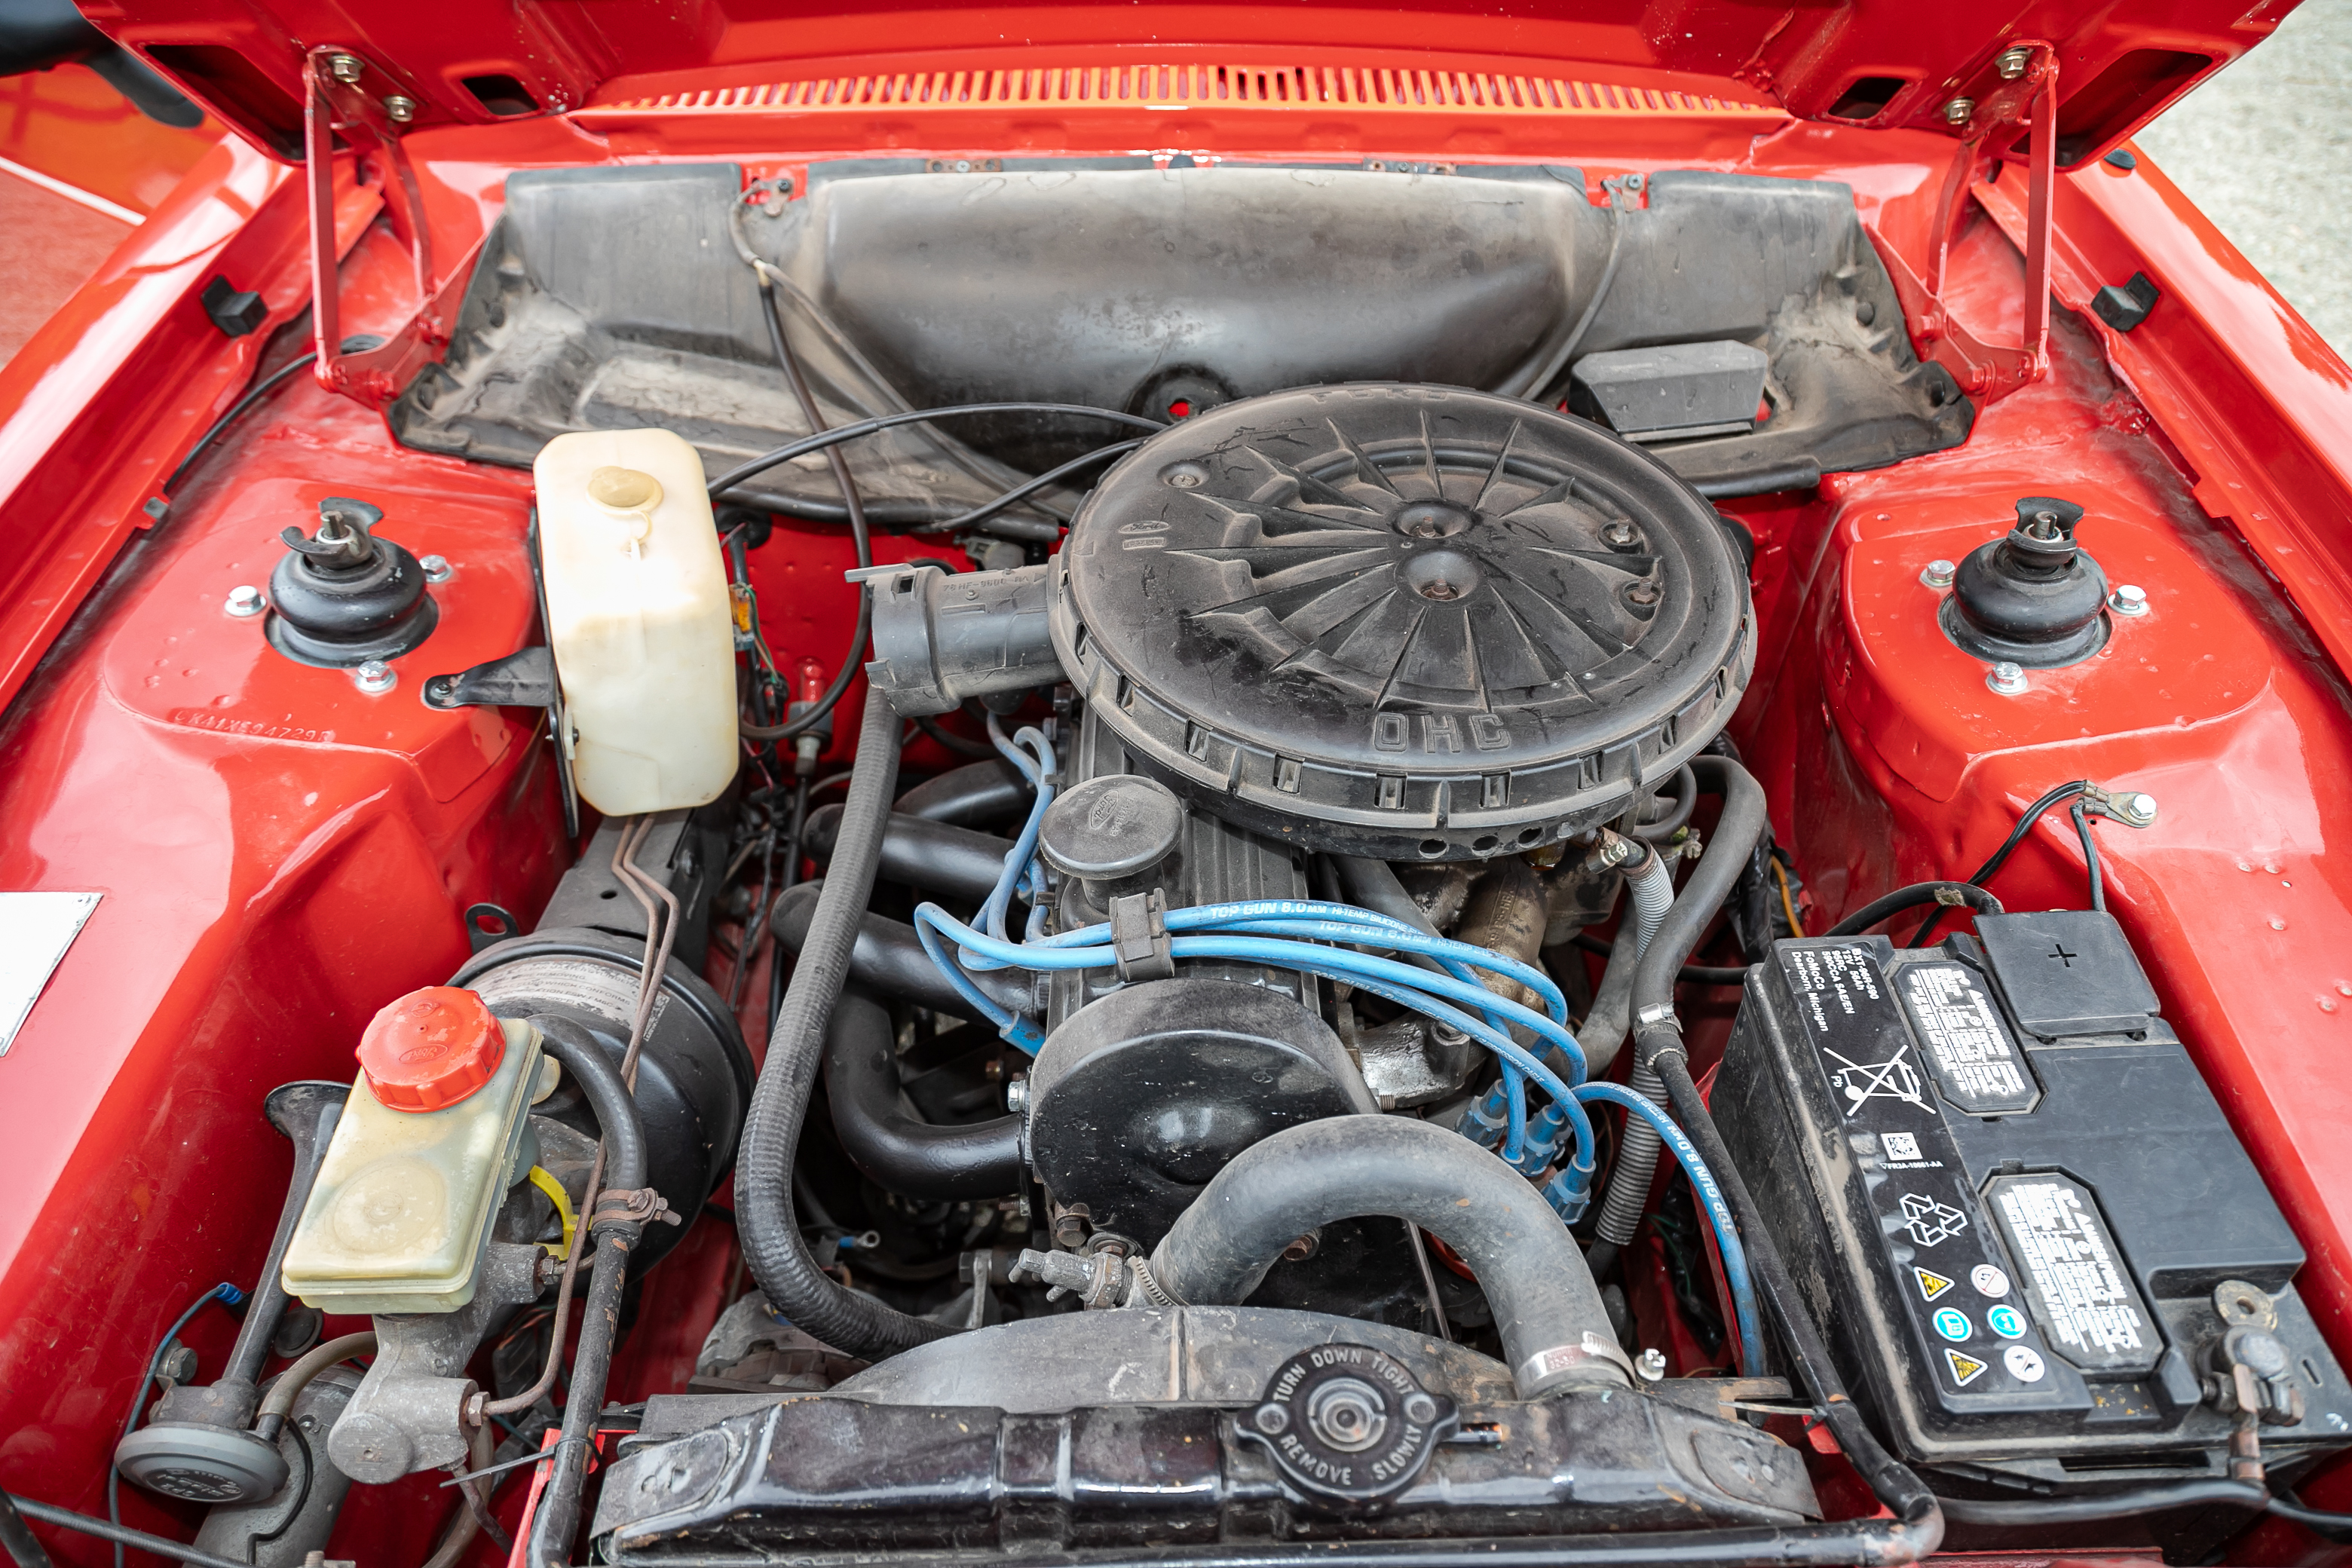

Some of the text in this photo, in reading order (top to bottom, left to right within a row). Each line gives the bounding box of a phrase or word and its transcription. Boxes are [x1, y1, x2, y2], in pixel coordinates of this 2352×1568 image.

[1374, 712, 1511, 754] OHC
[1210, 905, 1239, 919] TOP
[1244, 902, 1277, 915] GUN
[1331, 906, 1369, 920] HI-TEMP
[1369, 913, 1408, 933] SILICONE
[1319, 920, 1349, 932] TOP
[1350, 925, 1384, 937] GUN
[1436, 938, 1473, 952] HI-TEMP
[536, 972, 586, 980] REMOVING
[1802, 951, 1825, 990] FoMoCo
[1831, 950, 1848, 972] 95RC
[1842, 949, 1865, 991] 12V 56Ah
[545, 979, 577, 988] WHICH
[578, 985, 632, 1006] CONFORMS
[1791, 951, 1829, 1032] Dearborn, Michigan
[1821, 951, 1855, 1014] 590CCA SAE/EN
[1830, 1075, 1844, 1088] Pb
[1695, 1165, 1720, 1199] GUN
[1713, 1202, 1735, 1234] TOP
[1272, 1348, 1416, 1403] TURN DOWN TIGHT
[1280, 1423, 1423, 1487] REMOVE SLOWLY
